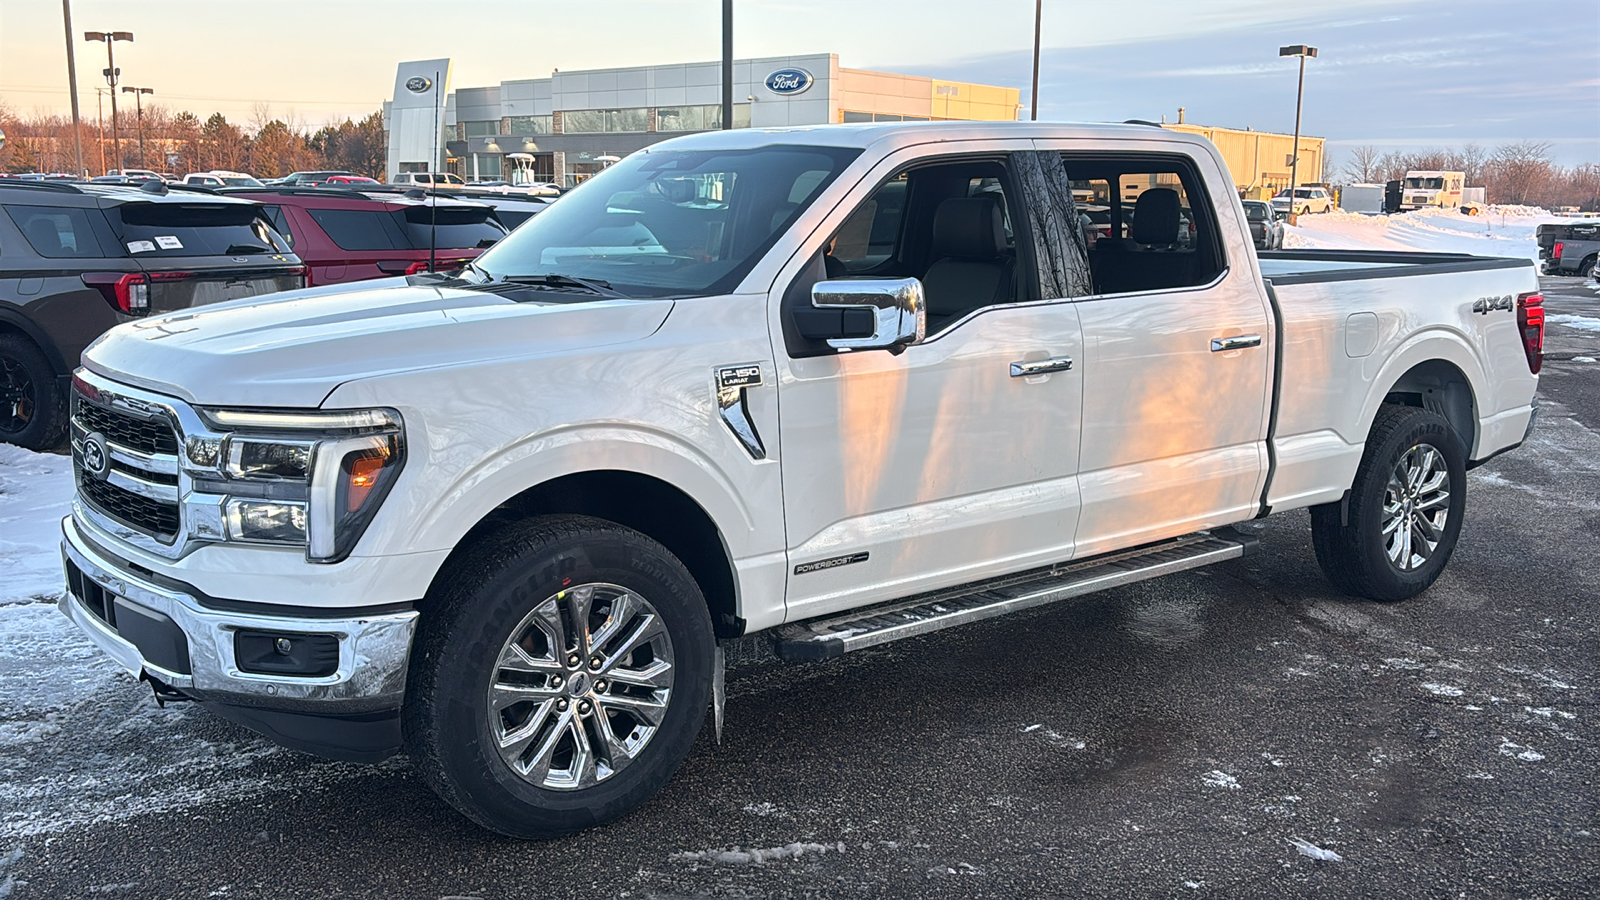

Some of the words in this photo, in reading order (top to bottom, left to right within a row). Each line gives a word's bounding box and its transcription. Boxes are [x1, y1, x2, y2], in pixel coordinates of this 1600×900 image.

[773, 74, 799, 89] Ford
[1473, 295, 1513, 315] 4x4
[722, 368, 759, 379] F-150
[86, 442, 101, 469] Ford
[796, 556, 853, 573] POWERBOOST
